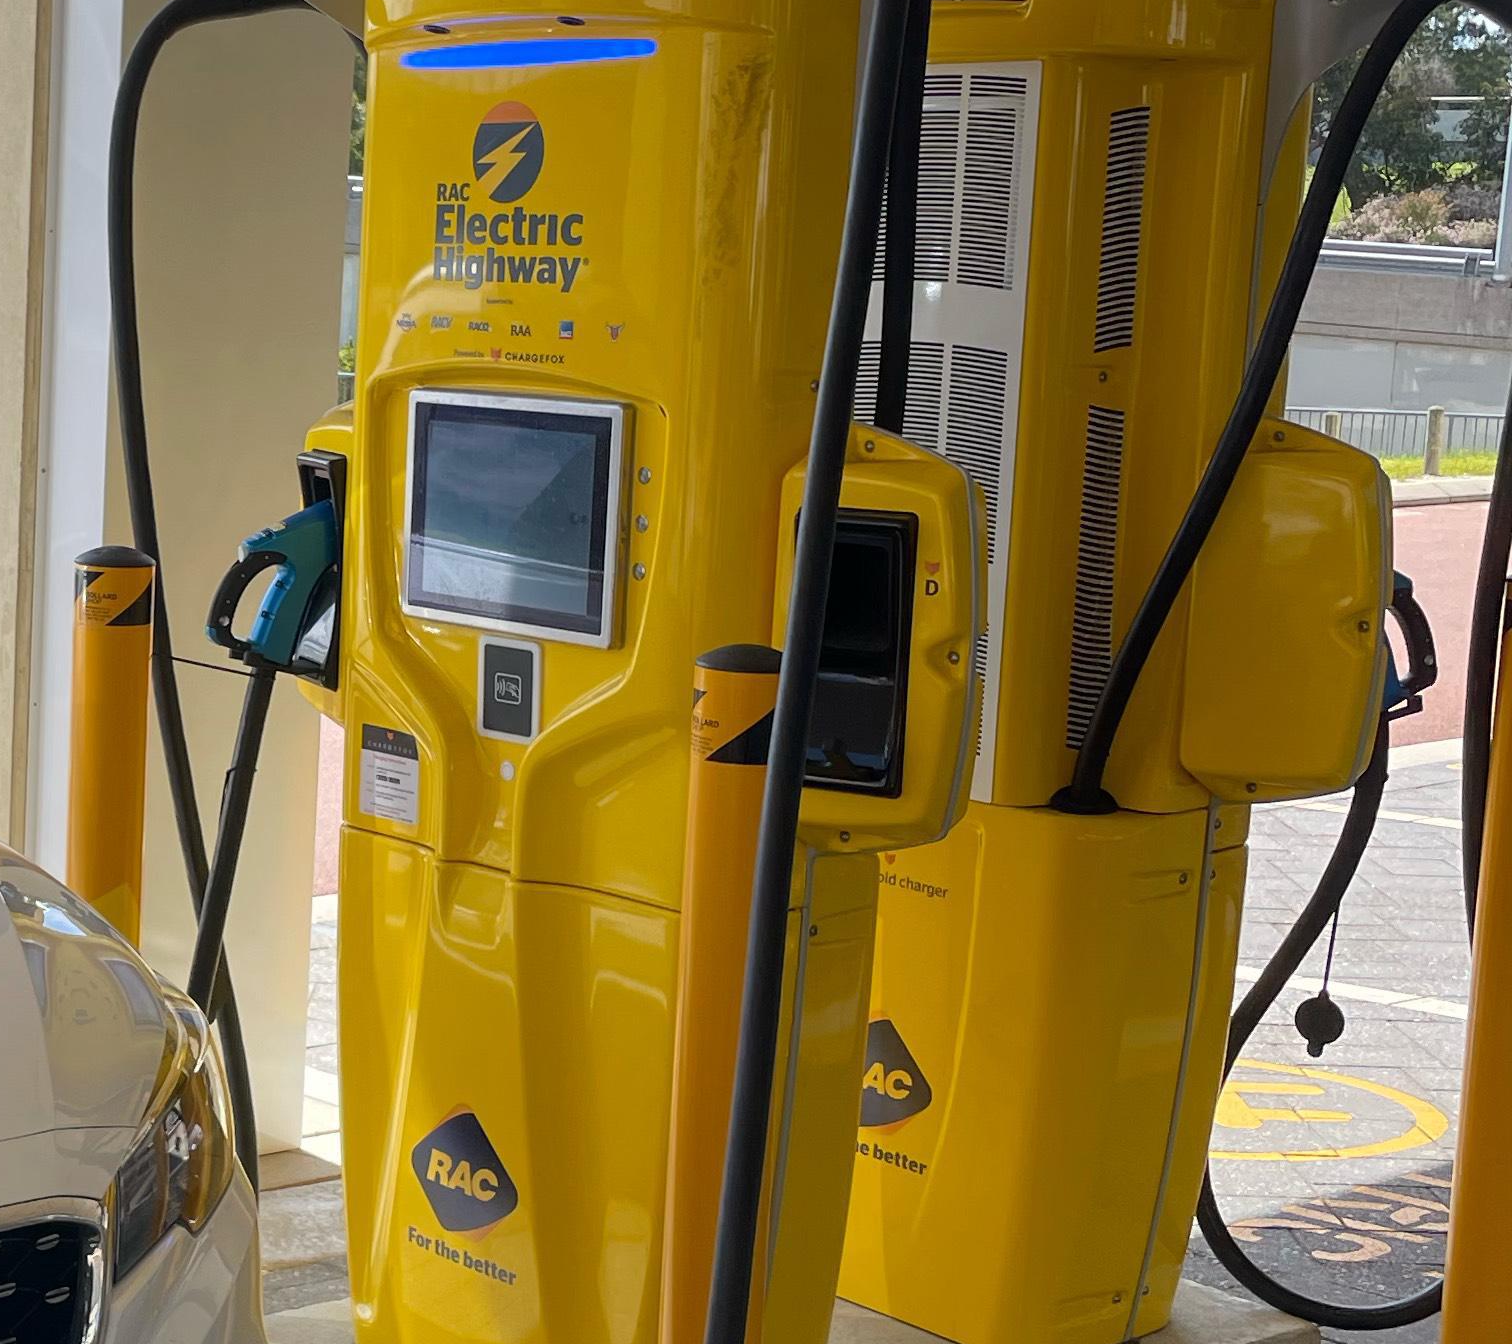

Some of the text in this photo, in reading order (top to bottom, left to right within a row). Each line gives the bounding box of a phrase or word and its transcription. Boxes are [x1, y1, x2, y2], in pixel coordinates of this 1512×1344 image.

[436, 182, 471, 202] RAC
[434, 204, 584, 246] Electric
[432, 246, 582, 293] Highway
[510, 324, 532, 337] RAA
[504, 351, 565, 365] CHARGEFOX
[924, 579, 939, 597] D
[899, 876, 949, 899] charger
[863, 1061, 913, 1100] AC
[426, 1147, 499, 1202] RAC
[872, 1143, 928, 1175] better
[407, 1225, 517, 1286] For the better
